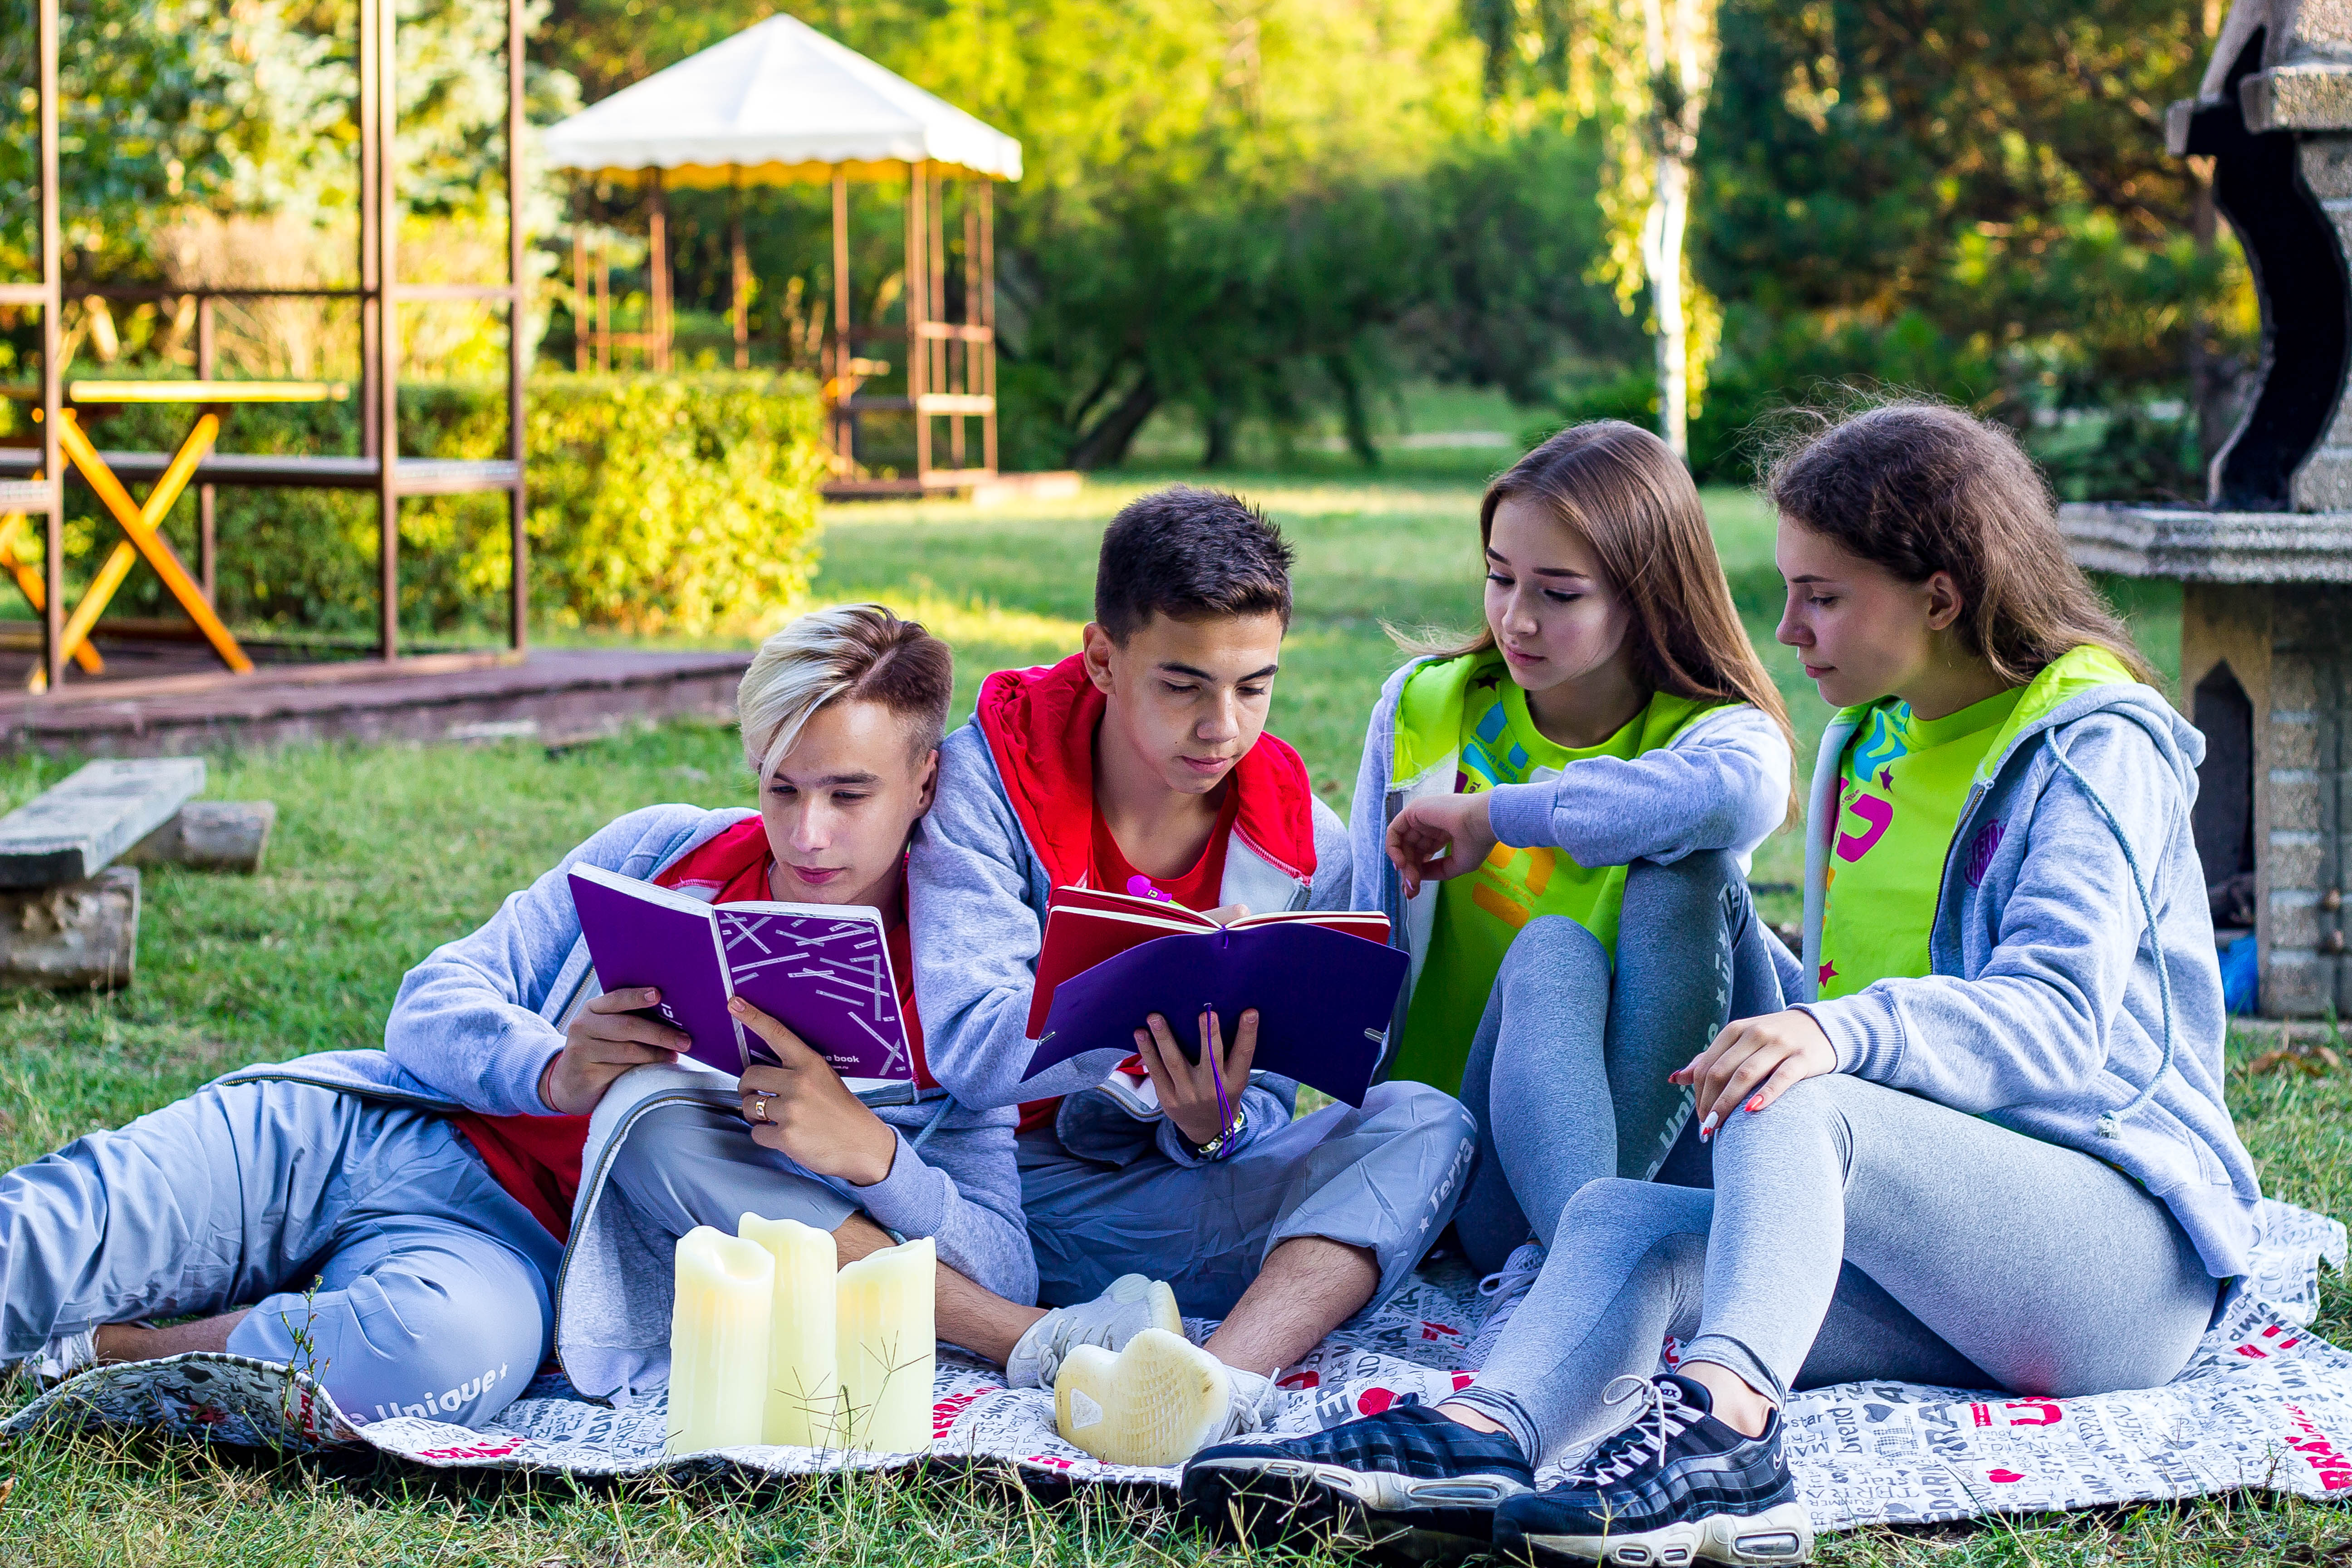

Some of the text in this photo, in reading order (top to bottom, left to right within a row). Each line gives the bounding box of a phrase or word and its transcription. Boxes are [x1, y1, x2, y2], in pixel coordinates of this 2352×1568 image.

[1427, 1137, 1475, 1213] Terra
[1329, 1358, 1350, 1372] yes
[1353, 1375, 1382, 1395] trend
[375, 1368, 496, 1420] Unique
[1661, 1389, 1677, 1397] ax
[1791, 1414, 1824, 1428] star
[1859, 1477, 1909, 1485] star
[1803, 1485, 1920, 1499] TERRA
